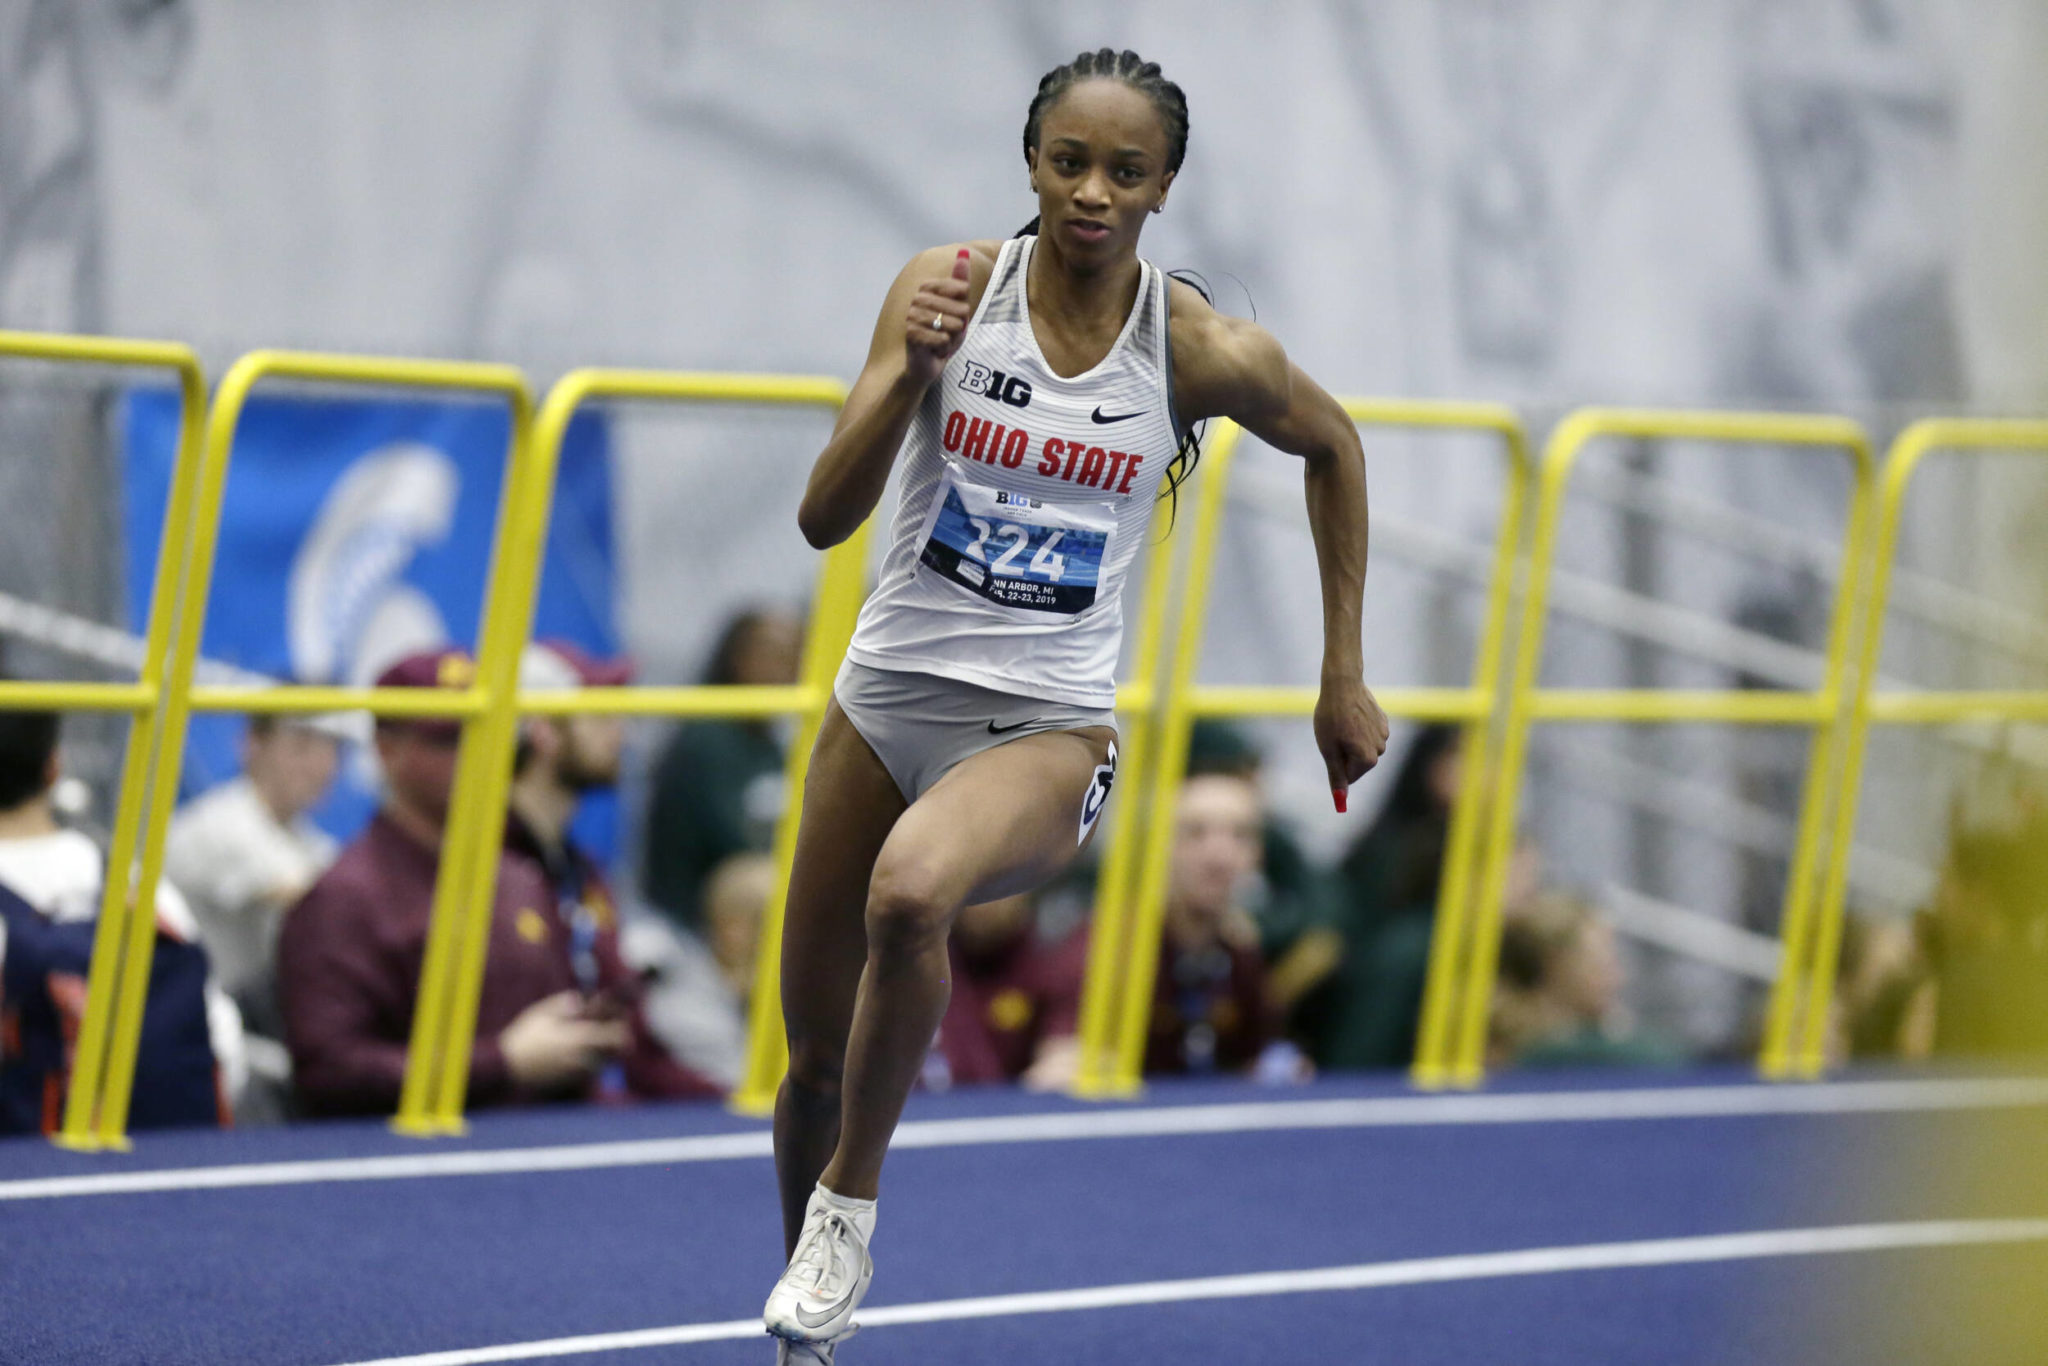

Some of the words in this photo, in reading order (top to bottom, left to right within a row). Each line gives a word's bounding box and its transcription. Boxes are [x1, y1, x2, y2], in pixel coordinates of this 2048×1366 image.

[943, 410, 1029, 469] OHIO
[1037, 437, 1143, 495] STATE
[1008, 580, 1041, 594] ARBOR,
[1043, 586, 1054, 595] MI
[1007, 591, 1033, 603] 22-23,
[1035, 594, 1057, 605] 2019
